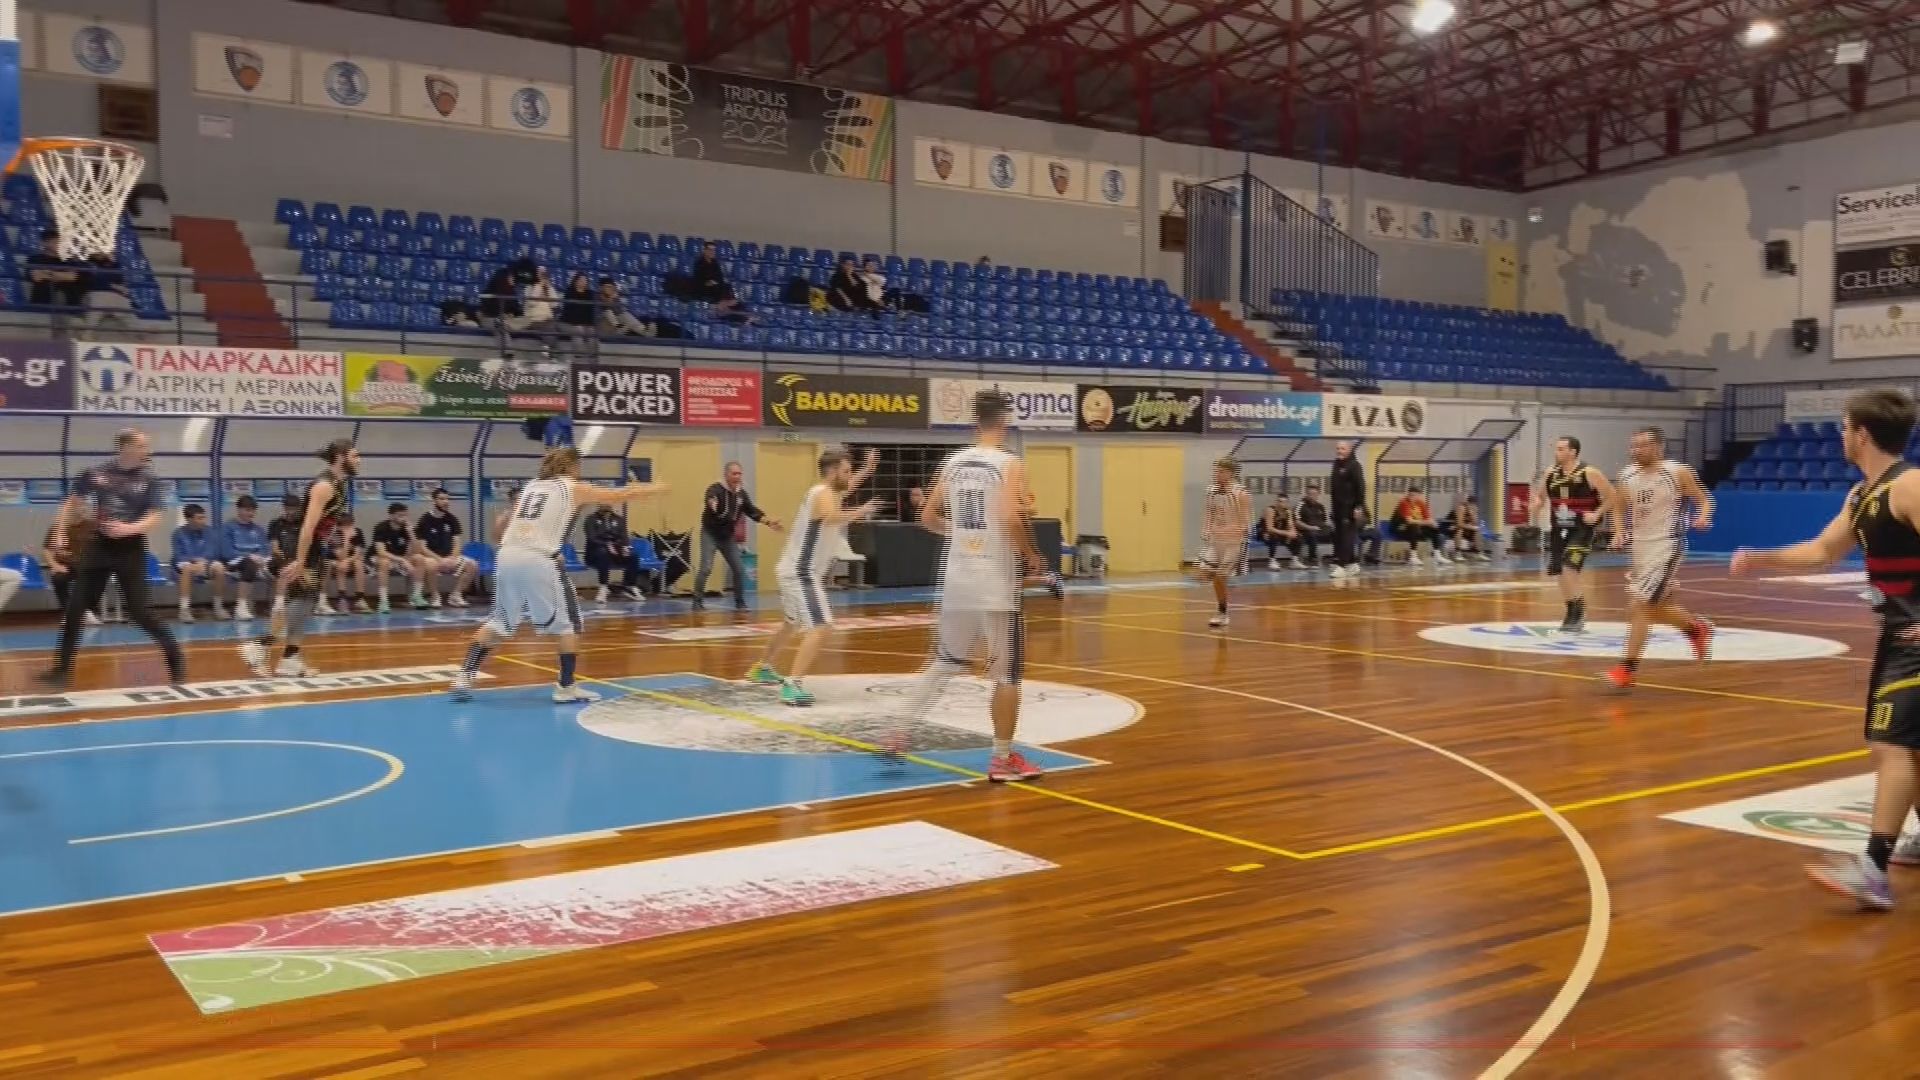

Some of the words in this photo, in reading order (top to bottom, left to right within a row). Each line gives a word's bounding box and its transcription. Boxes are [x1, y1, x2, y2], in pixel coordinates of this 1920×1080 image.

[720, 84, 789, 107] TRIPOLIS
[721, 102, 789, 123] ARCADIA
[135, 347, 339, 377] ΠΑΝΑΡΚΑΔΙΚΗ
[136, 375, 226, 394] ΙΑΤΡΙΚΗ
[234, 378, 338, 397] ΜΕΡΙΜΝΑ
[577, 371, 674, 395] POWER
[81, 397, 221, 414] ΜΑΓΝΗΤΙΚΗ
[242, 400, 342, 416] ΑΞΟΝΙΚΗ
[577, 393, 675, 416] PACKED
[795, 390, 920, 413] BADOUNAS
[1208, 395, 1321, 427] dromeisbc.gr
[1328, 404, 1398, 428] TAZA
[517, 491, 549, 520] 13
